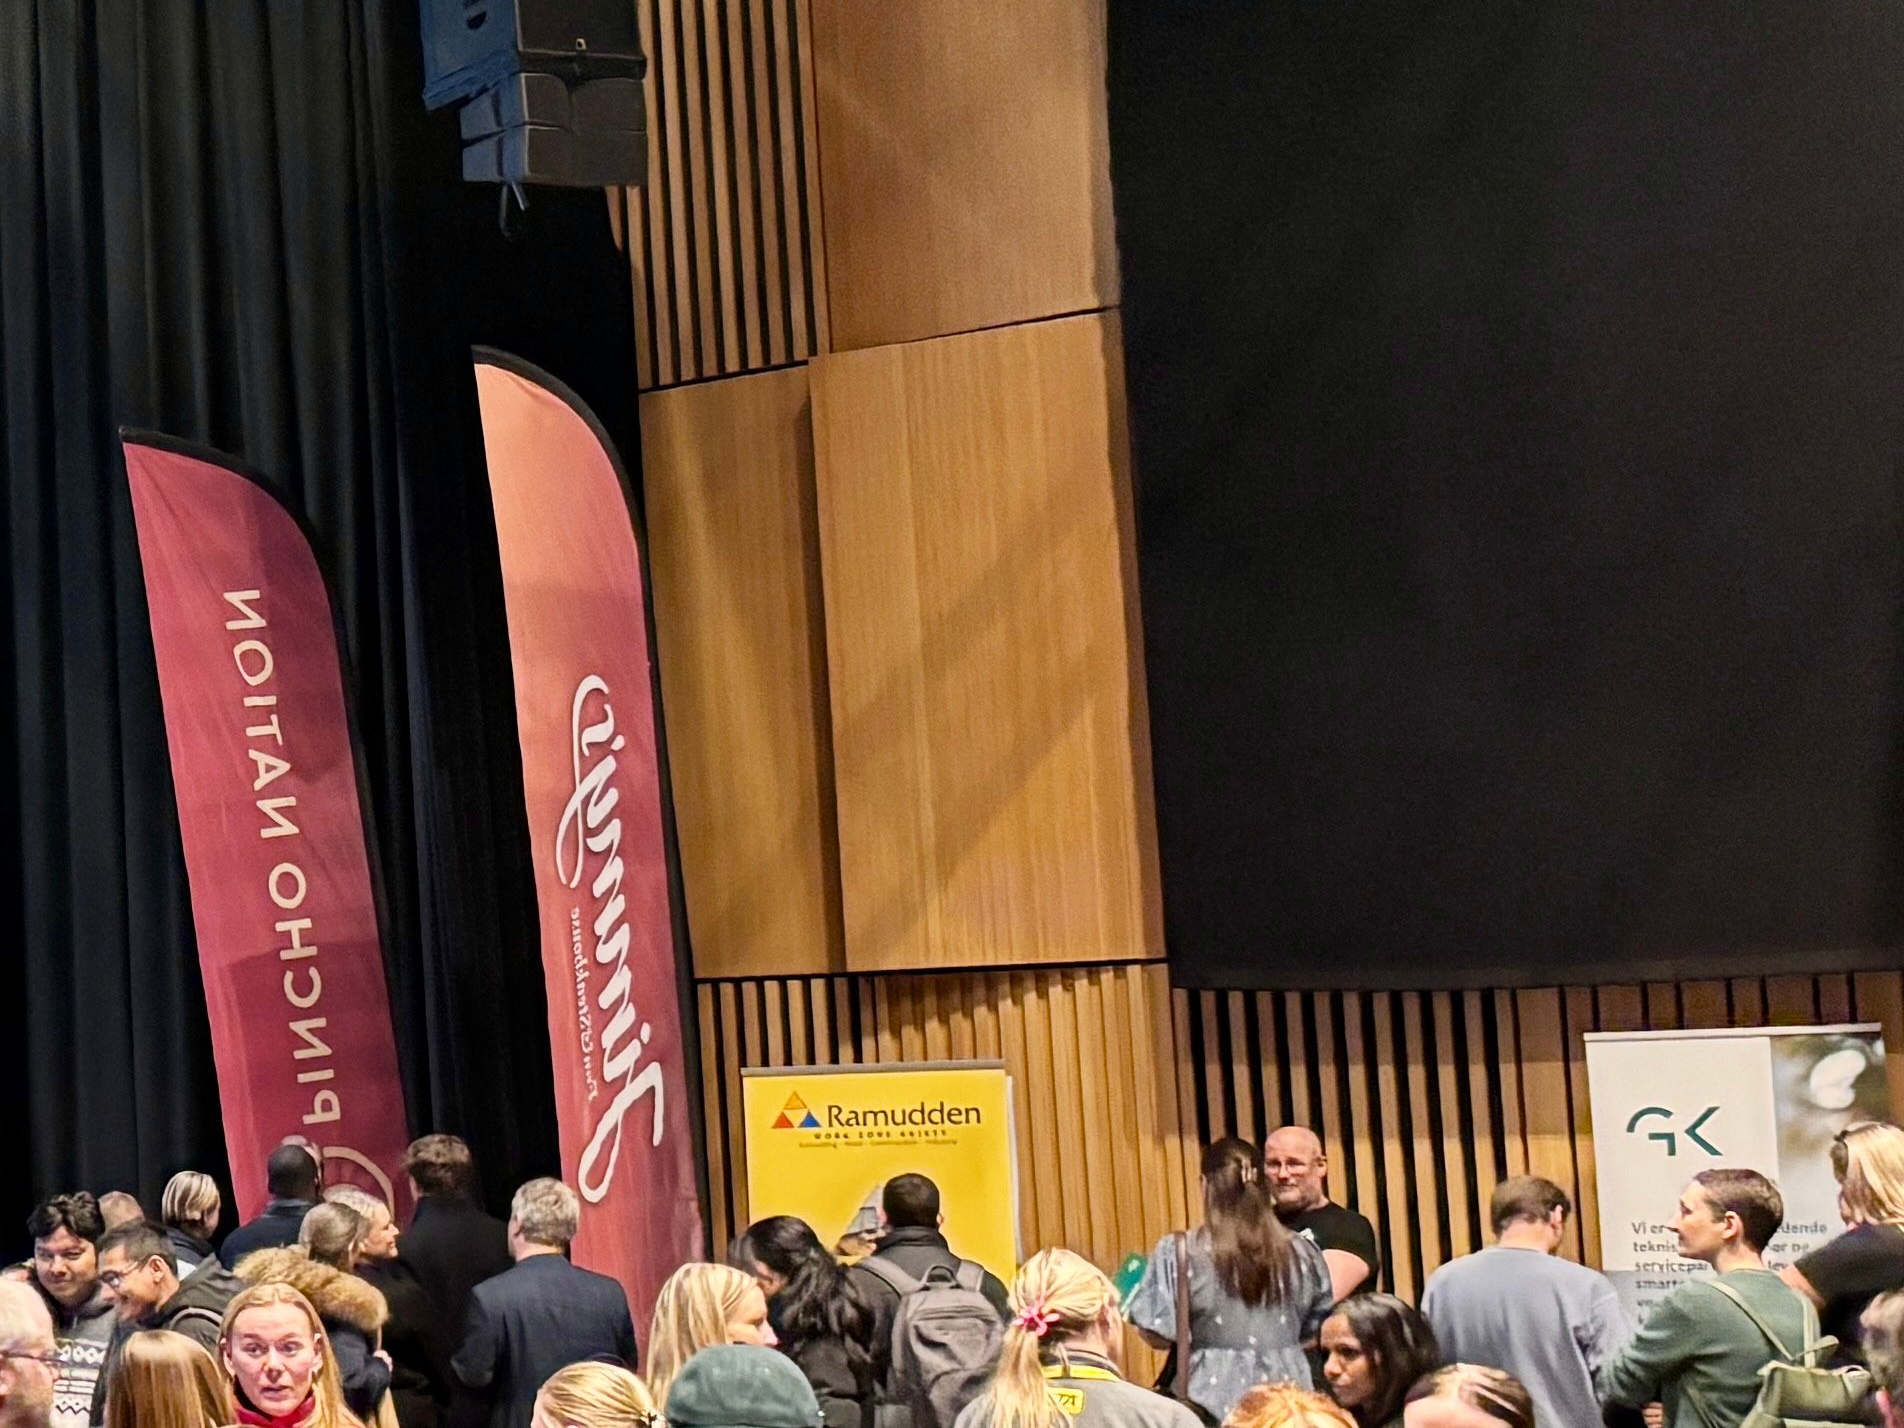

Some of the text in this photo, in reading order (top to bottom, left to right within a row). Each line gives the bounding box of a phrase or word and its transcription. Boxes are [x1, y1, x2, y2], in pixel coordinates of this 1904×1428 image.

[828, 1101, 982, 1128] Ramudden
[1626, 1105, 1723, 1157] GK
[1632, 1222, 1647, 1234] Vi
[1633, 1240, 1678, 1253] teknis
